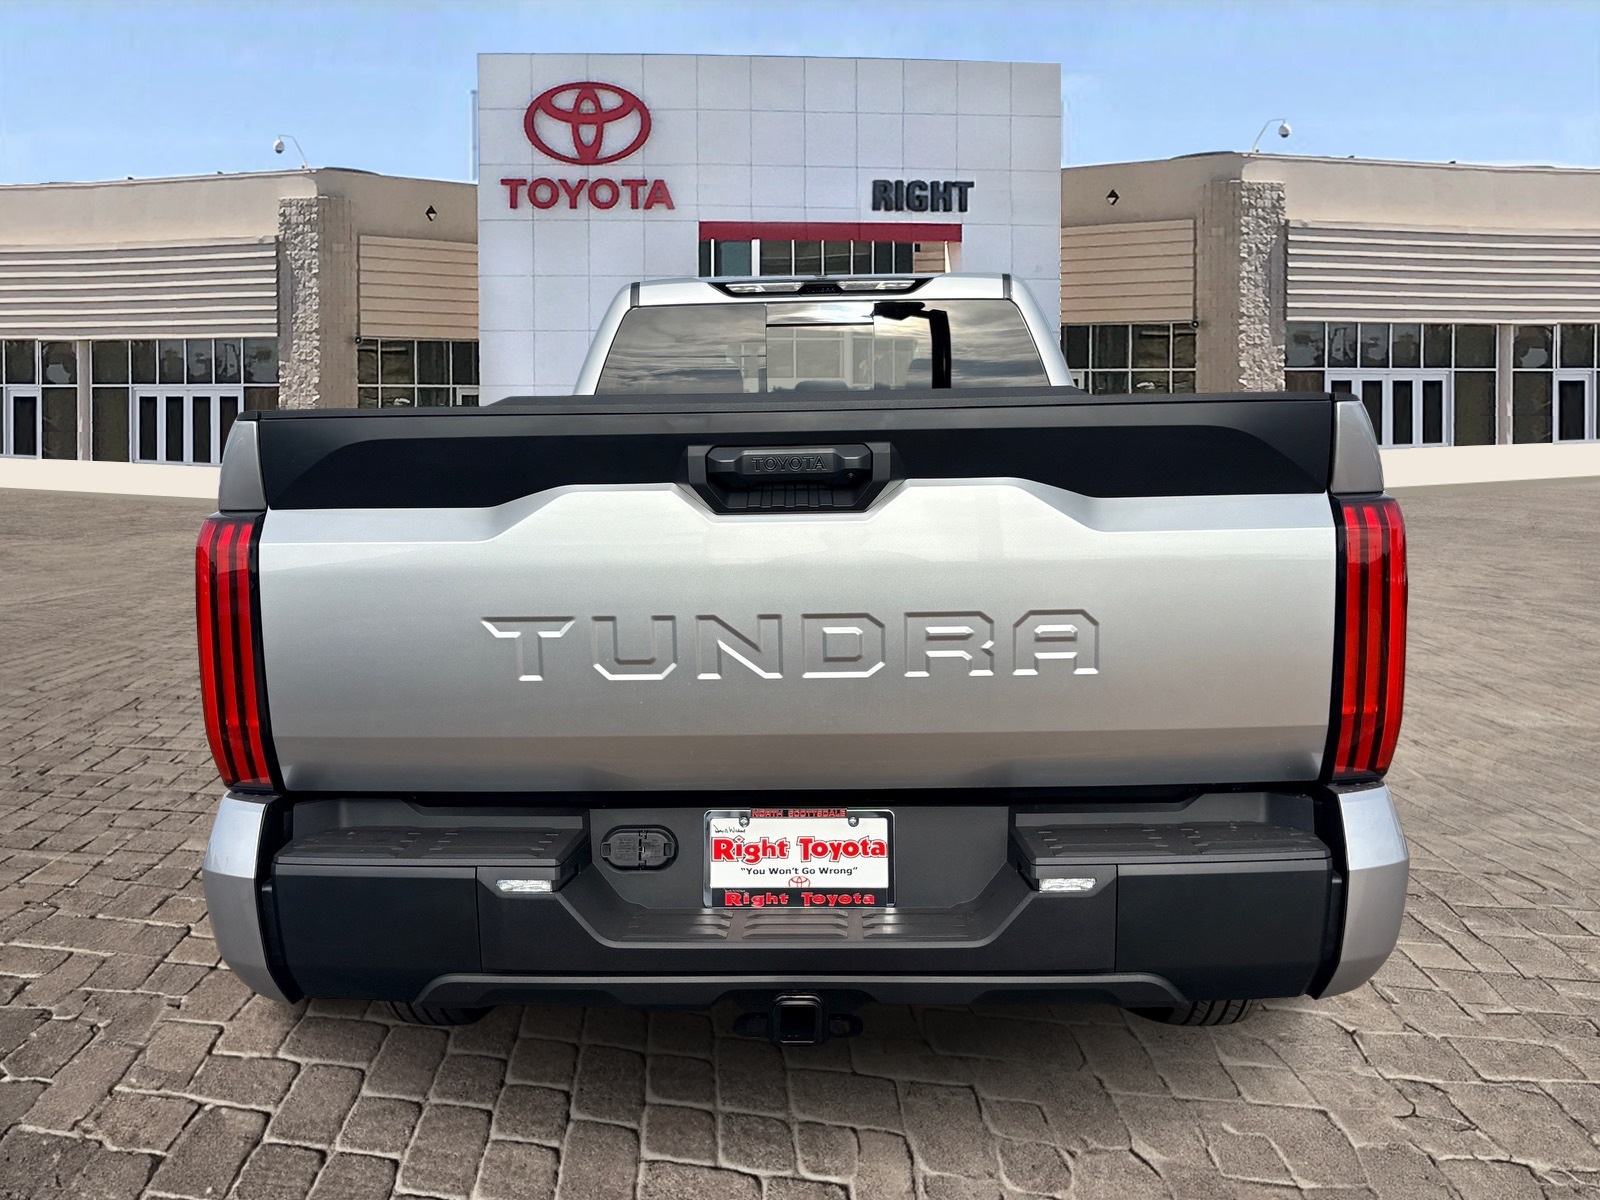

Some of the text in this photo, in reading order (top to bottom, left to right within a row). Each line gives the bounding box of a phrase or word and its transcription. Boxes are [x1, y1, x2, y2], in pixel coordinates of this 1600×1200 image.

[500, 178, 675, 210] TOYOTA
[871, 179, 975, 213] RIGHT
[751, 456, 828, 472] TOYOTA
[481, 609, 1100, 682] TUNDRA
[751, 809, 783, 818] NORTH
[711, 835, 888, 865] Right Toyota
[801, 867, 816, 875] Go
[724, 892, 875, 908] Right Toyota
